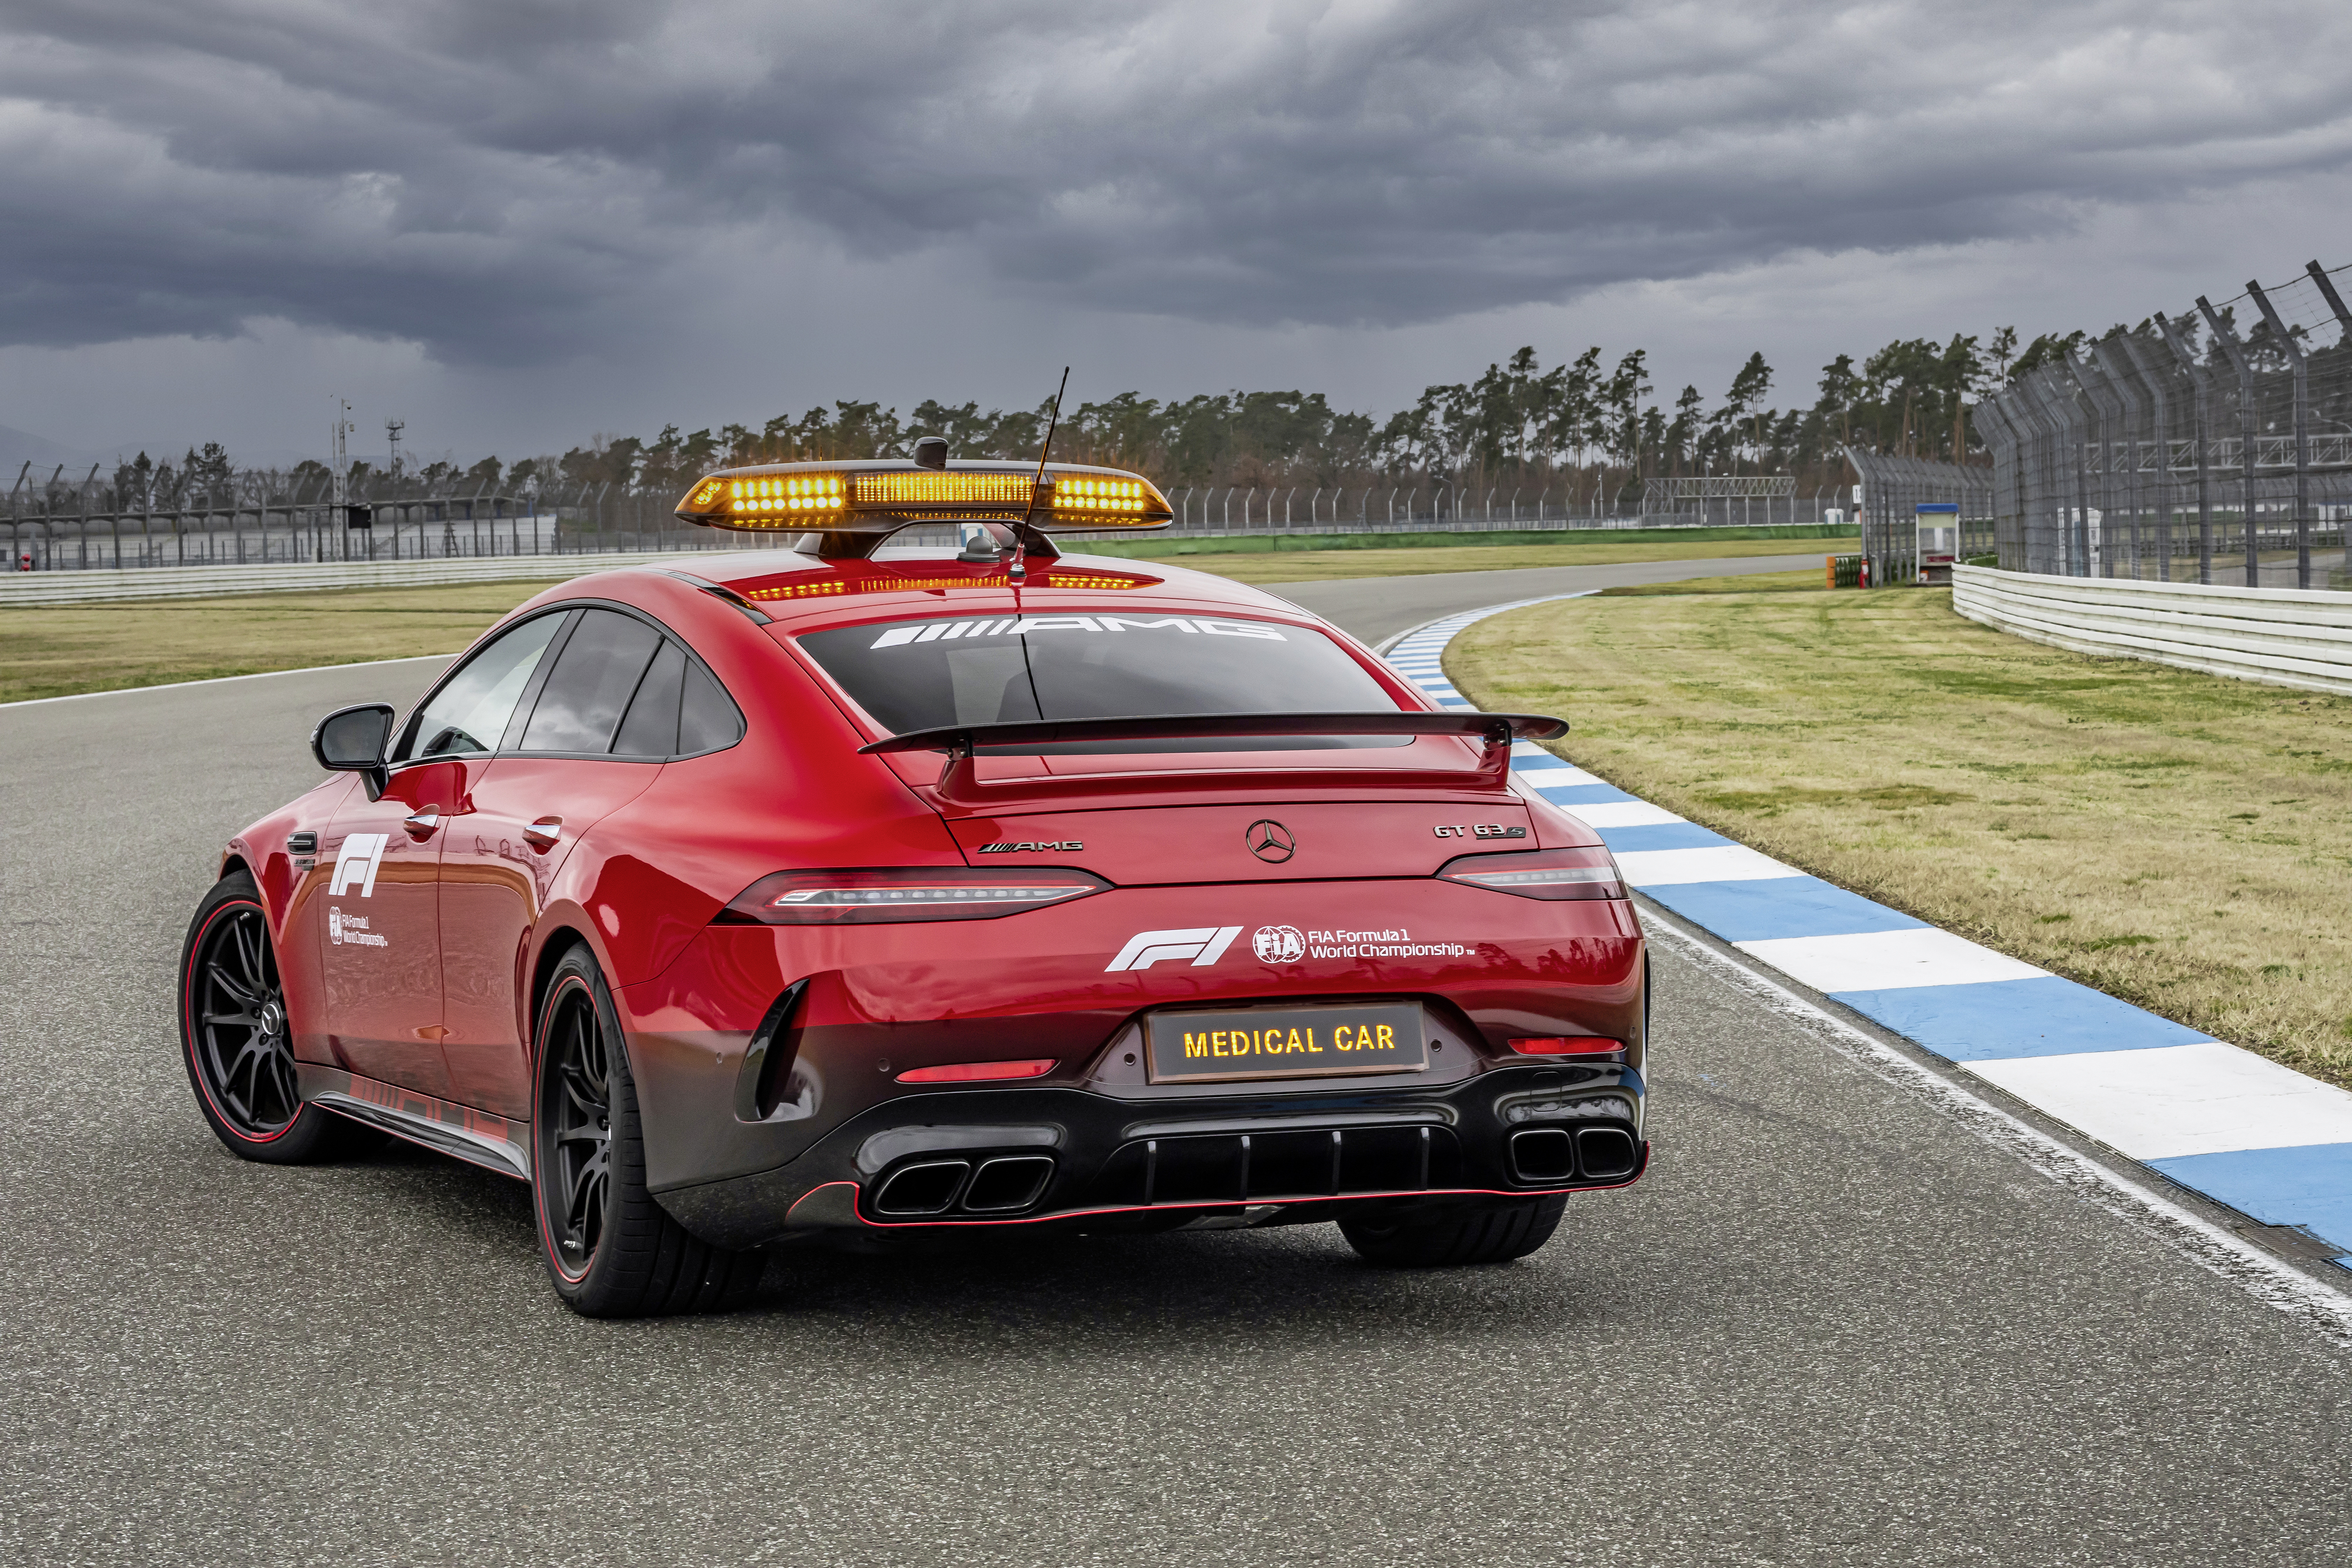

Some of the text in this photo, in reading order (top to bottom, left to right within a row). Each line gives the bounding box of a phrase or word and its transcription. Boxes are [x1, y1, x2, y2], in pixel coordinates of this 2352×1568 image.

[1006, 617, 1288, 642] AMG
[1433, 825, 1465, 838] GT
[1011, 841, 1083, 852] AMG
[328, 833, 390, 898] F1
[1308, 930, 1336, 943] FIA
[1104, 926, 1244, 972] F1
[1310, 944, 1357, 958] World
[1359, 943, 1464, 958] Championship
[1184, 1024, 1395, 1058] MEDICAL CAR
